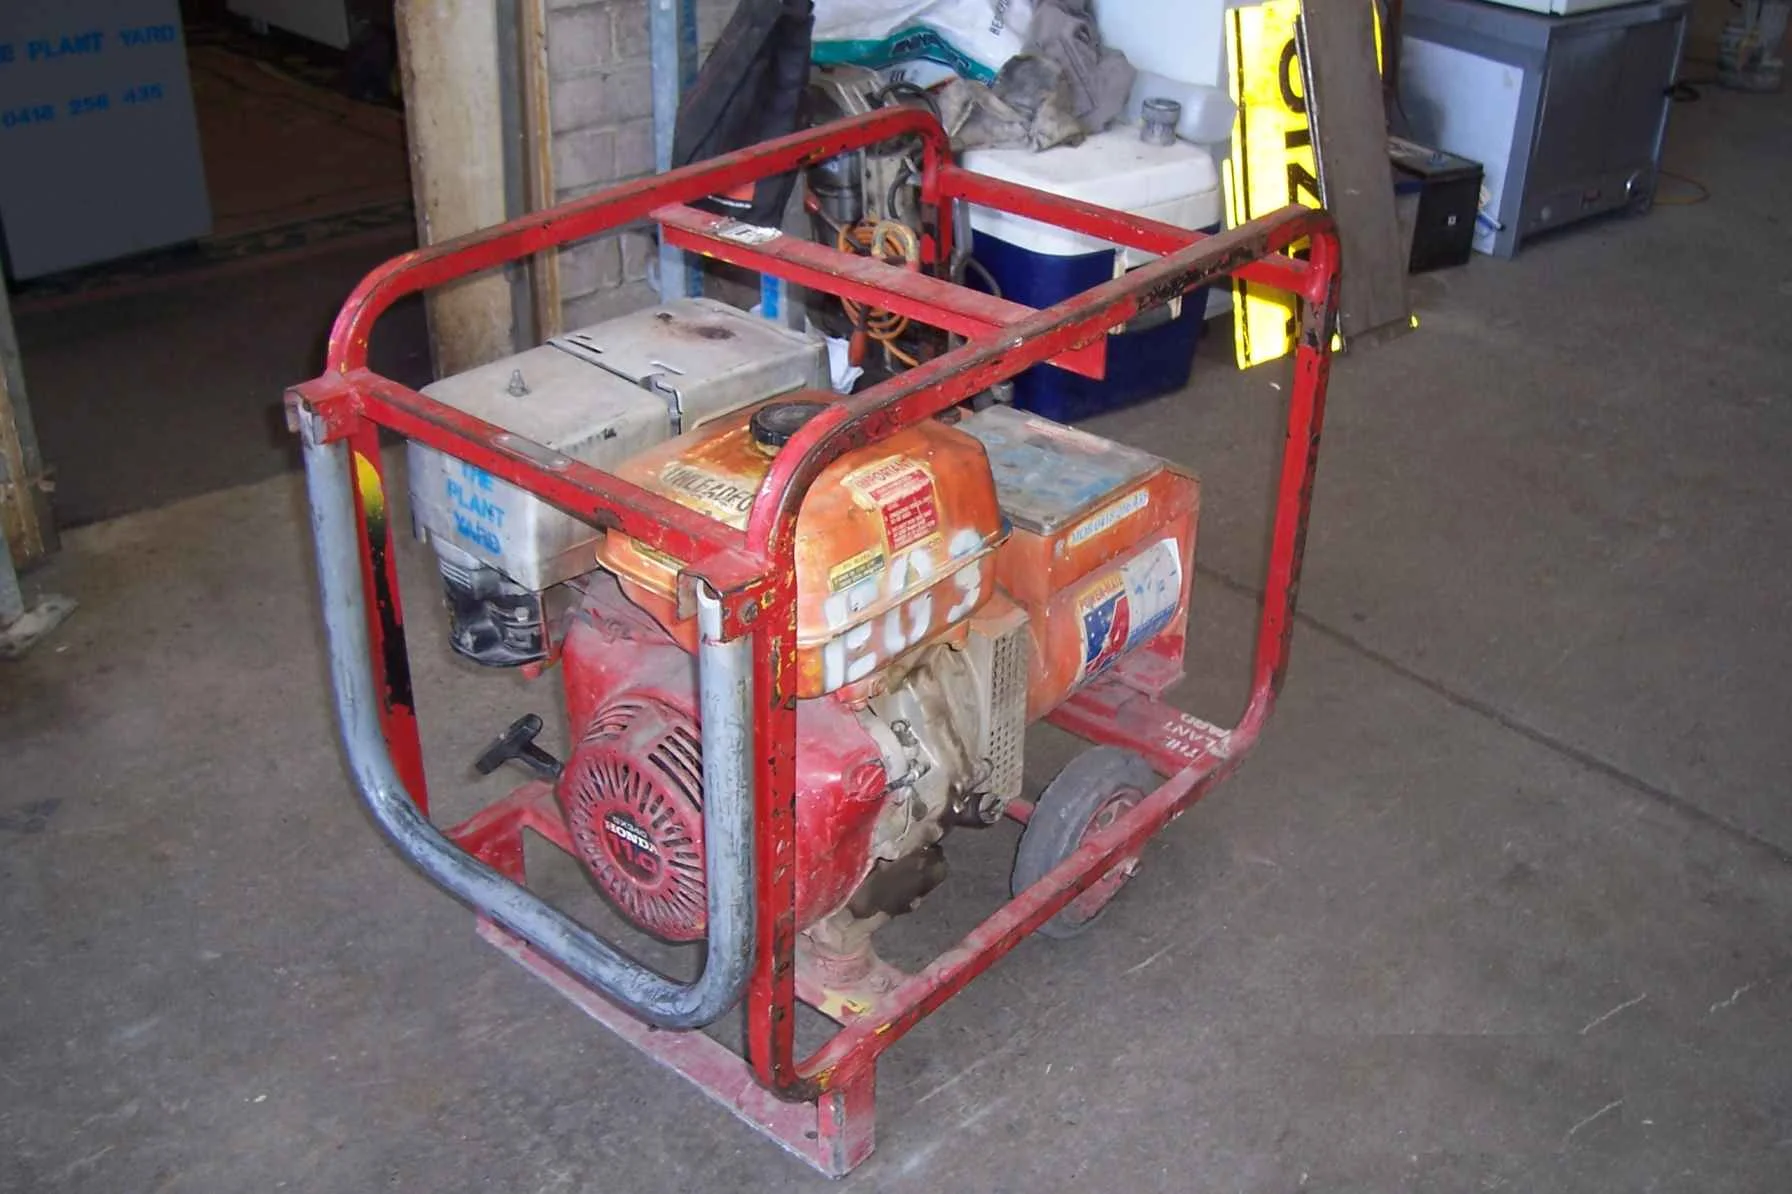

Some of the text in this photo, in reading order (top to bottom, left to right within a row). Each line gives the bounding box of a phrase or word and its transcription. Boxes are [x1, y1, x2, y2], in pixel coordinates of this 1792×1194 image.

[27, 31, 104, 61] PLANT
[119, 25, 176, 46] YARD
[447, 478, 505, 528] PLANT
[453, 511, 502, 555] YARD
[605, 820, 658, 855] HONDA
